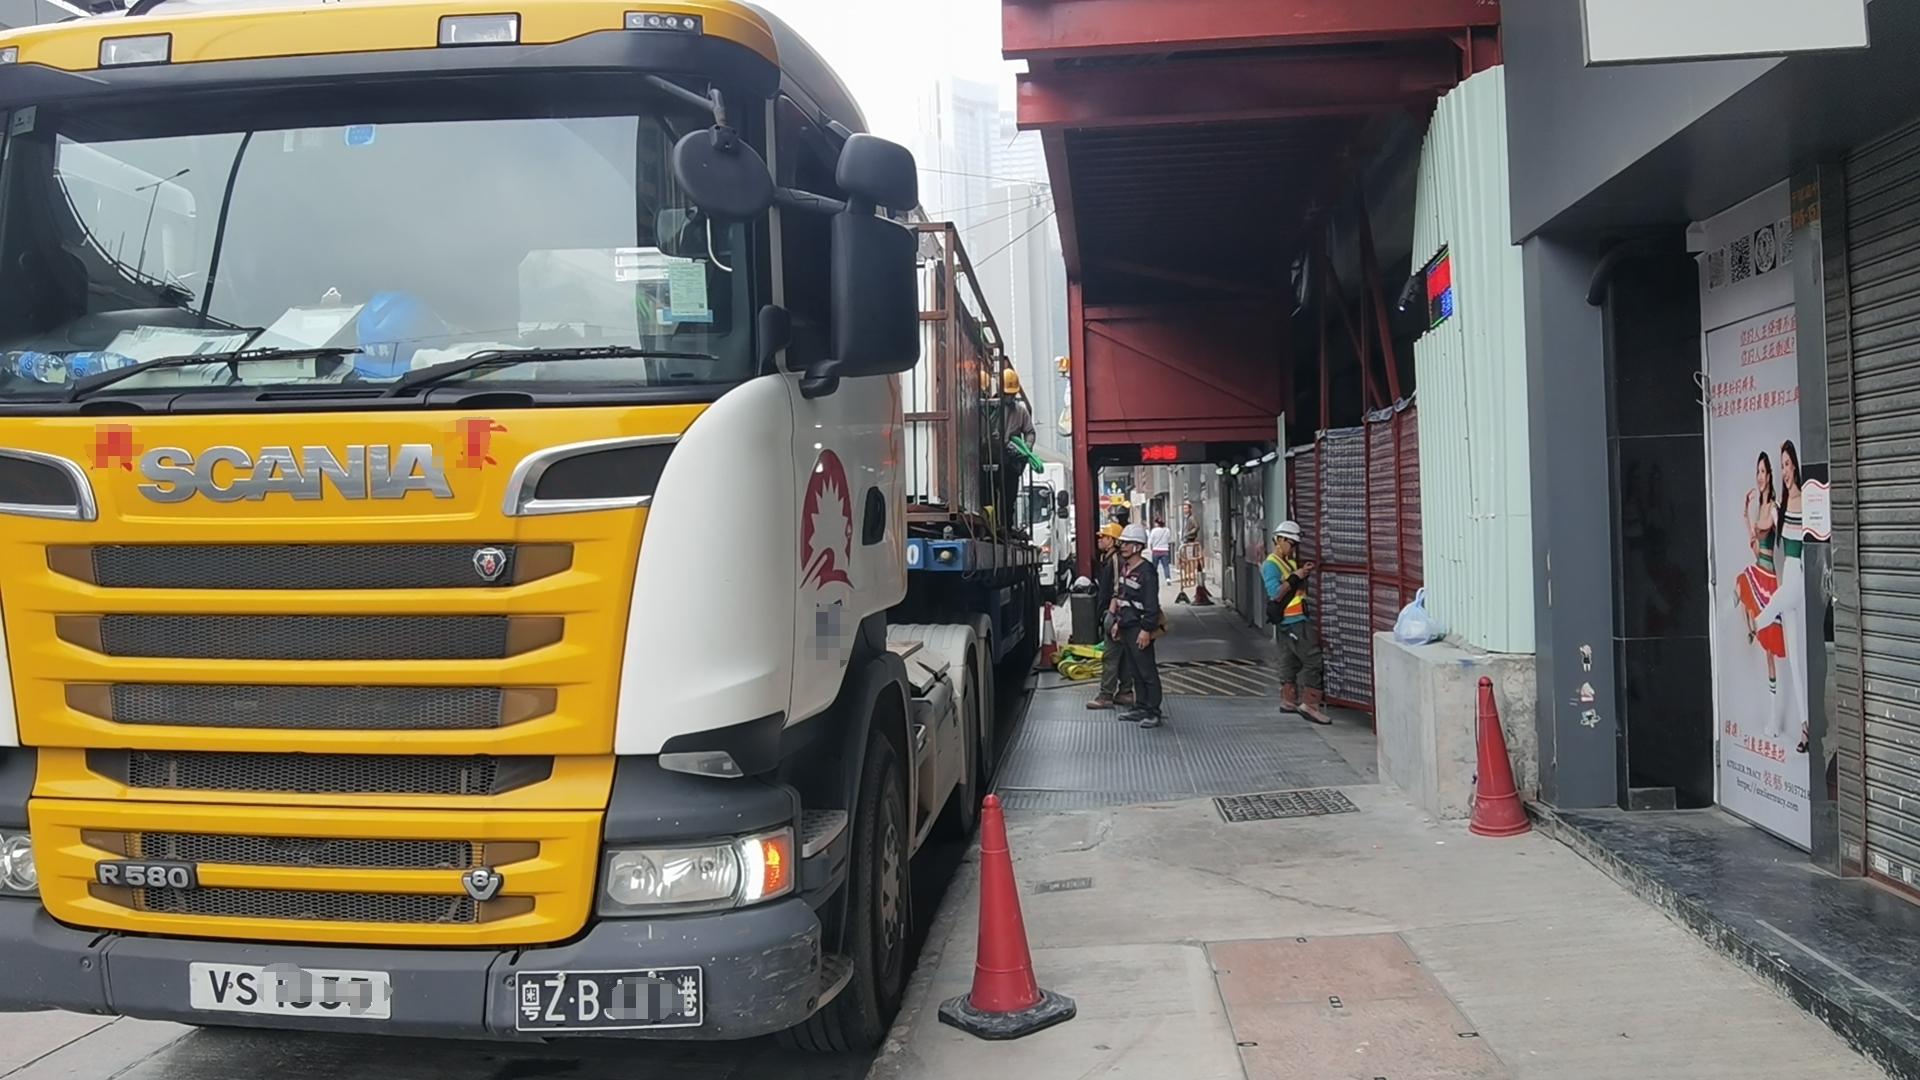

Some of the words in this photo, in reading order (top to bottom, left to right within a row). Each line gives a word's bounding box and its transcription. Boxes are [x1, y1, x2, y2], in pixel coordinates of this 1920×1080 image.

[137, 444, 455, 503] SCANIA
[99, 864, 121, 885] R
[125, 866, 189, 888] 580
